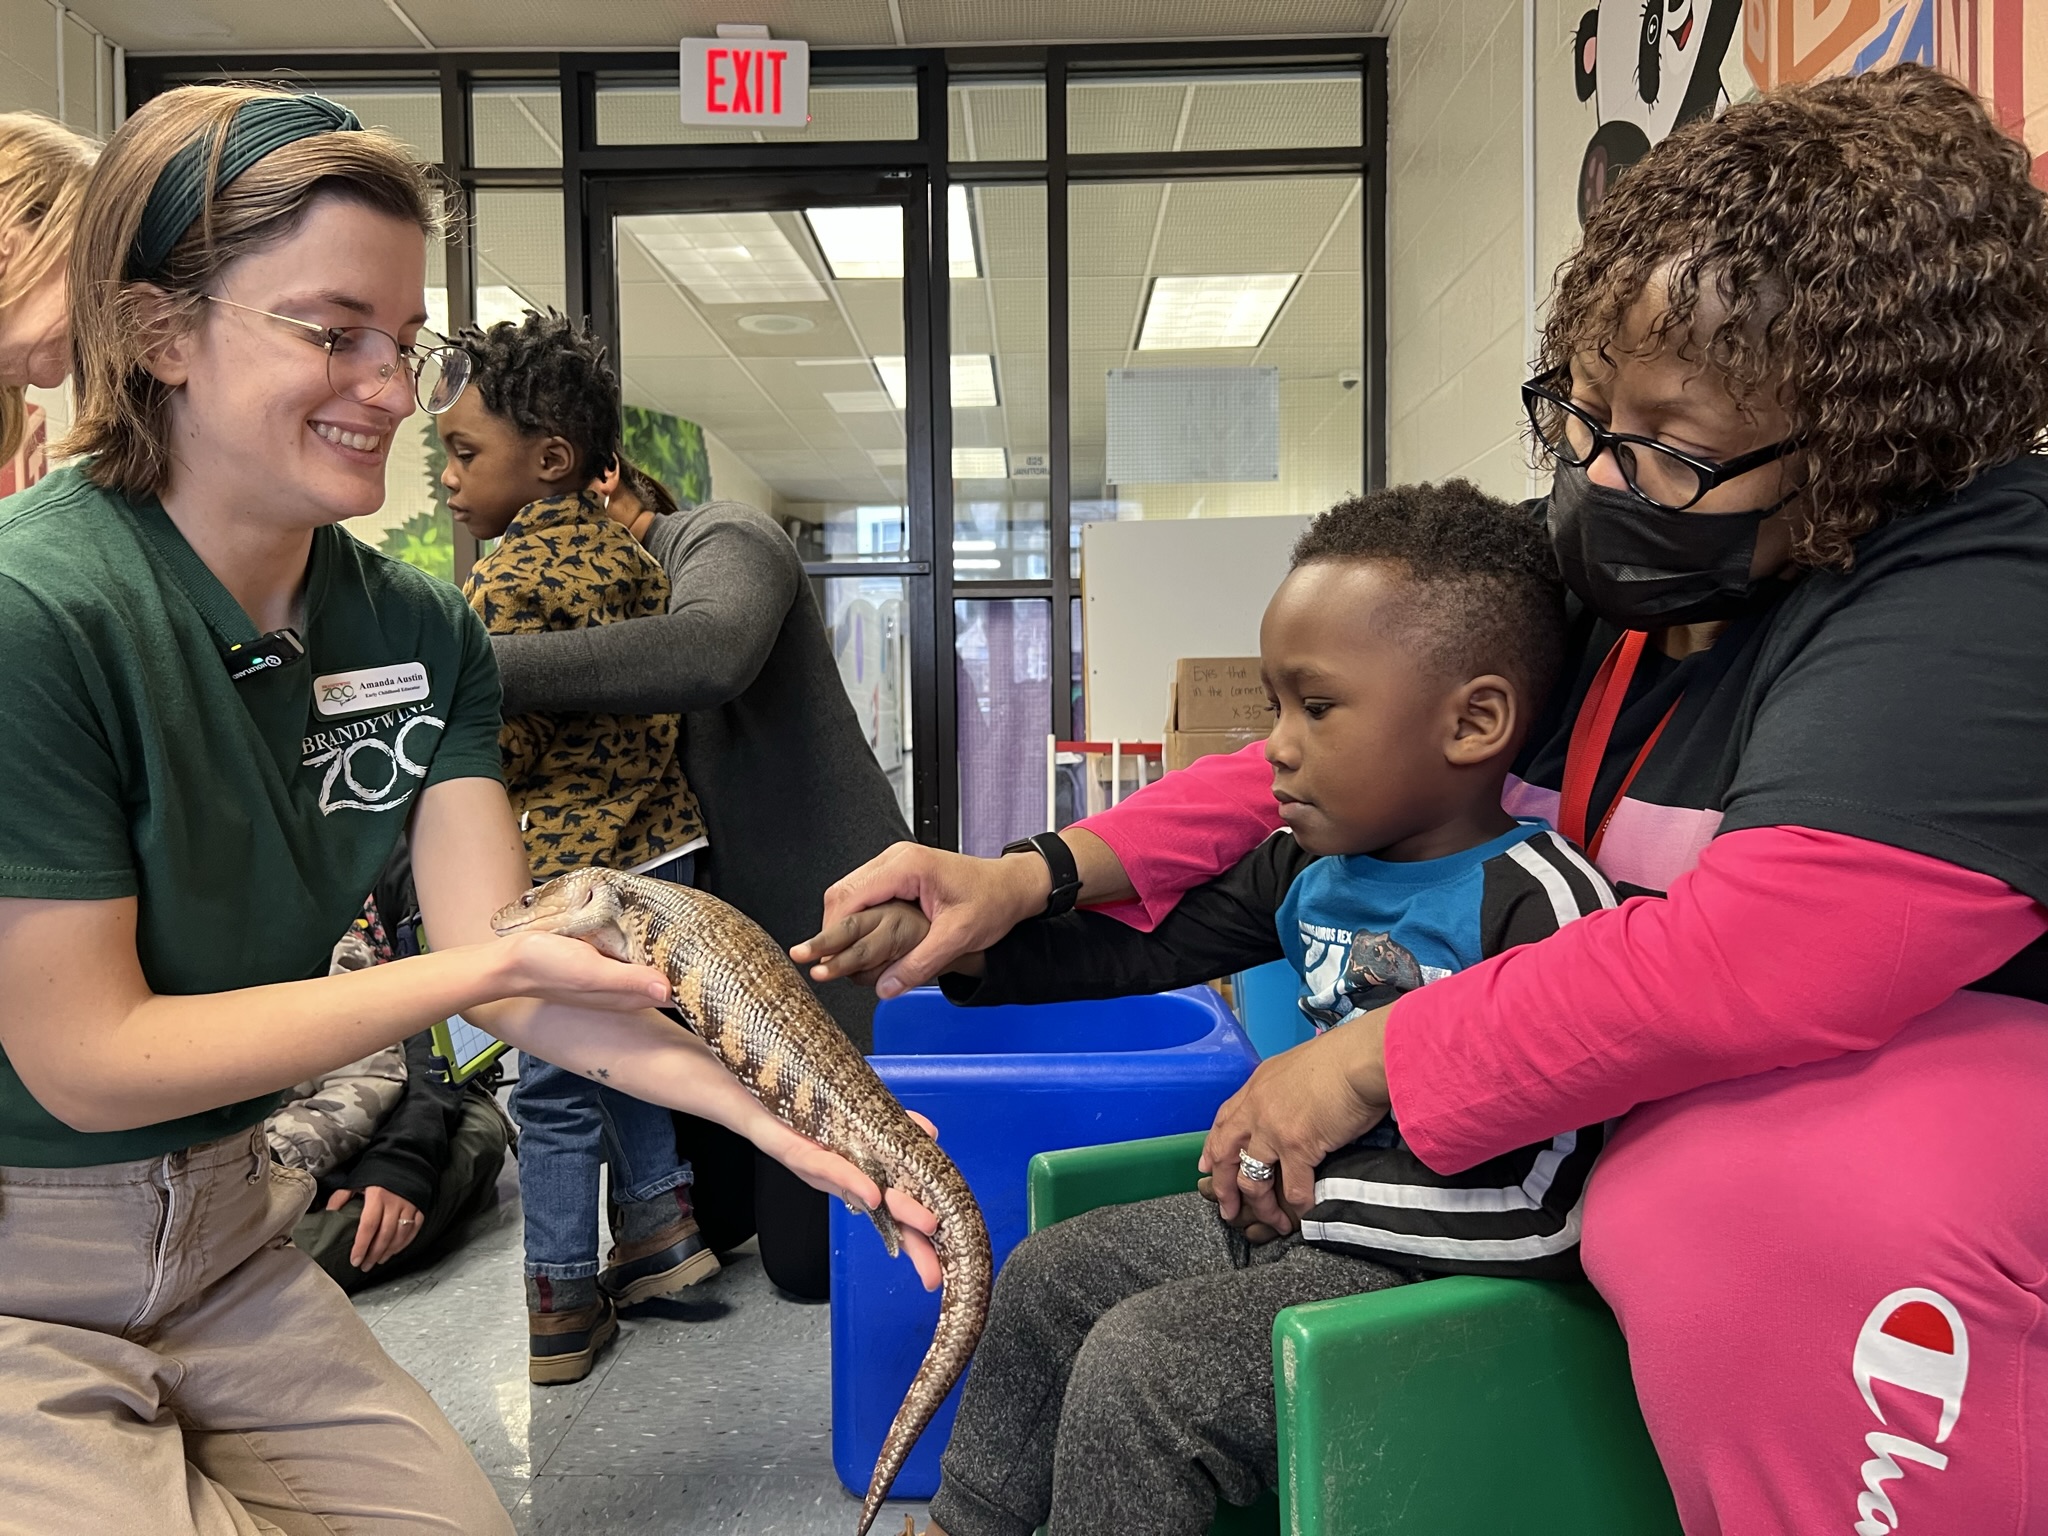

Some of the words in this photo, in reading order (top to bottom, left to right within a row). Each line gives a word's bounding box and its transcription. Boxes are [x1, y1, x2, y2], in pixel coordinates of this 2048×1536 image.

[707, 49, 788, 115] EXIT
[359, 678, 395, 691] Amanda
[396, 673, 424, 685] Austin
[1193, 665, 1218, 682] Eyes
[1226, 665, 1247, 679] that
[1193, 686, 1202, 697] in
[1208, 685, 1222, 697] the
[1242, 704, 1263, 720] 35
[1336, 928, 1353, 945] REX
